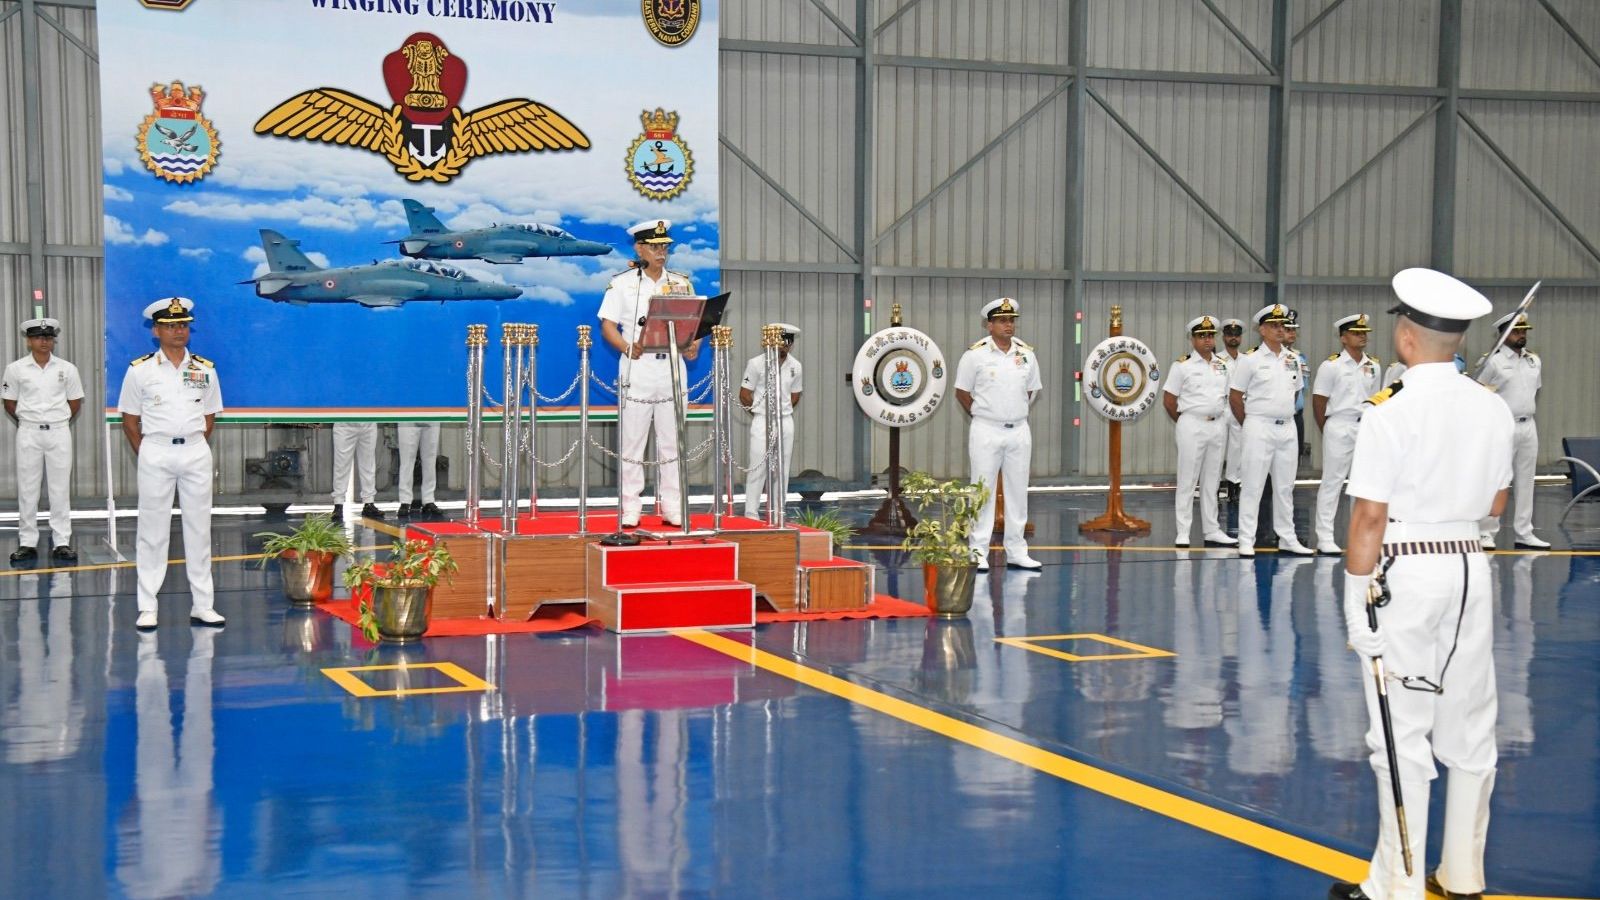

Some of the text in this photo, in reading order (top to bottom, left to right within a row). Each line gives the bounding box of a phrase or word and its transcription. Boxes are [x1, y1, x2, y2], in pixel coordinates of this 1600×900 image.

[427, 0, 556, 23] CEREMONY
[645, 0, 697, 42] EASTERN NAVAL COMMAND
[923, 392, 941, 413] 551
